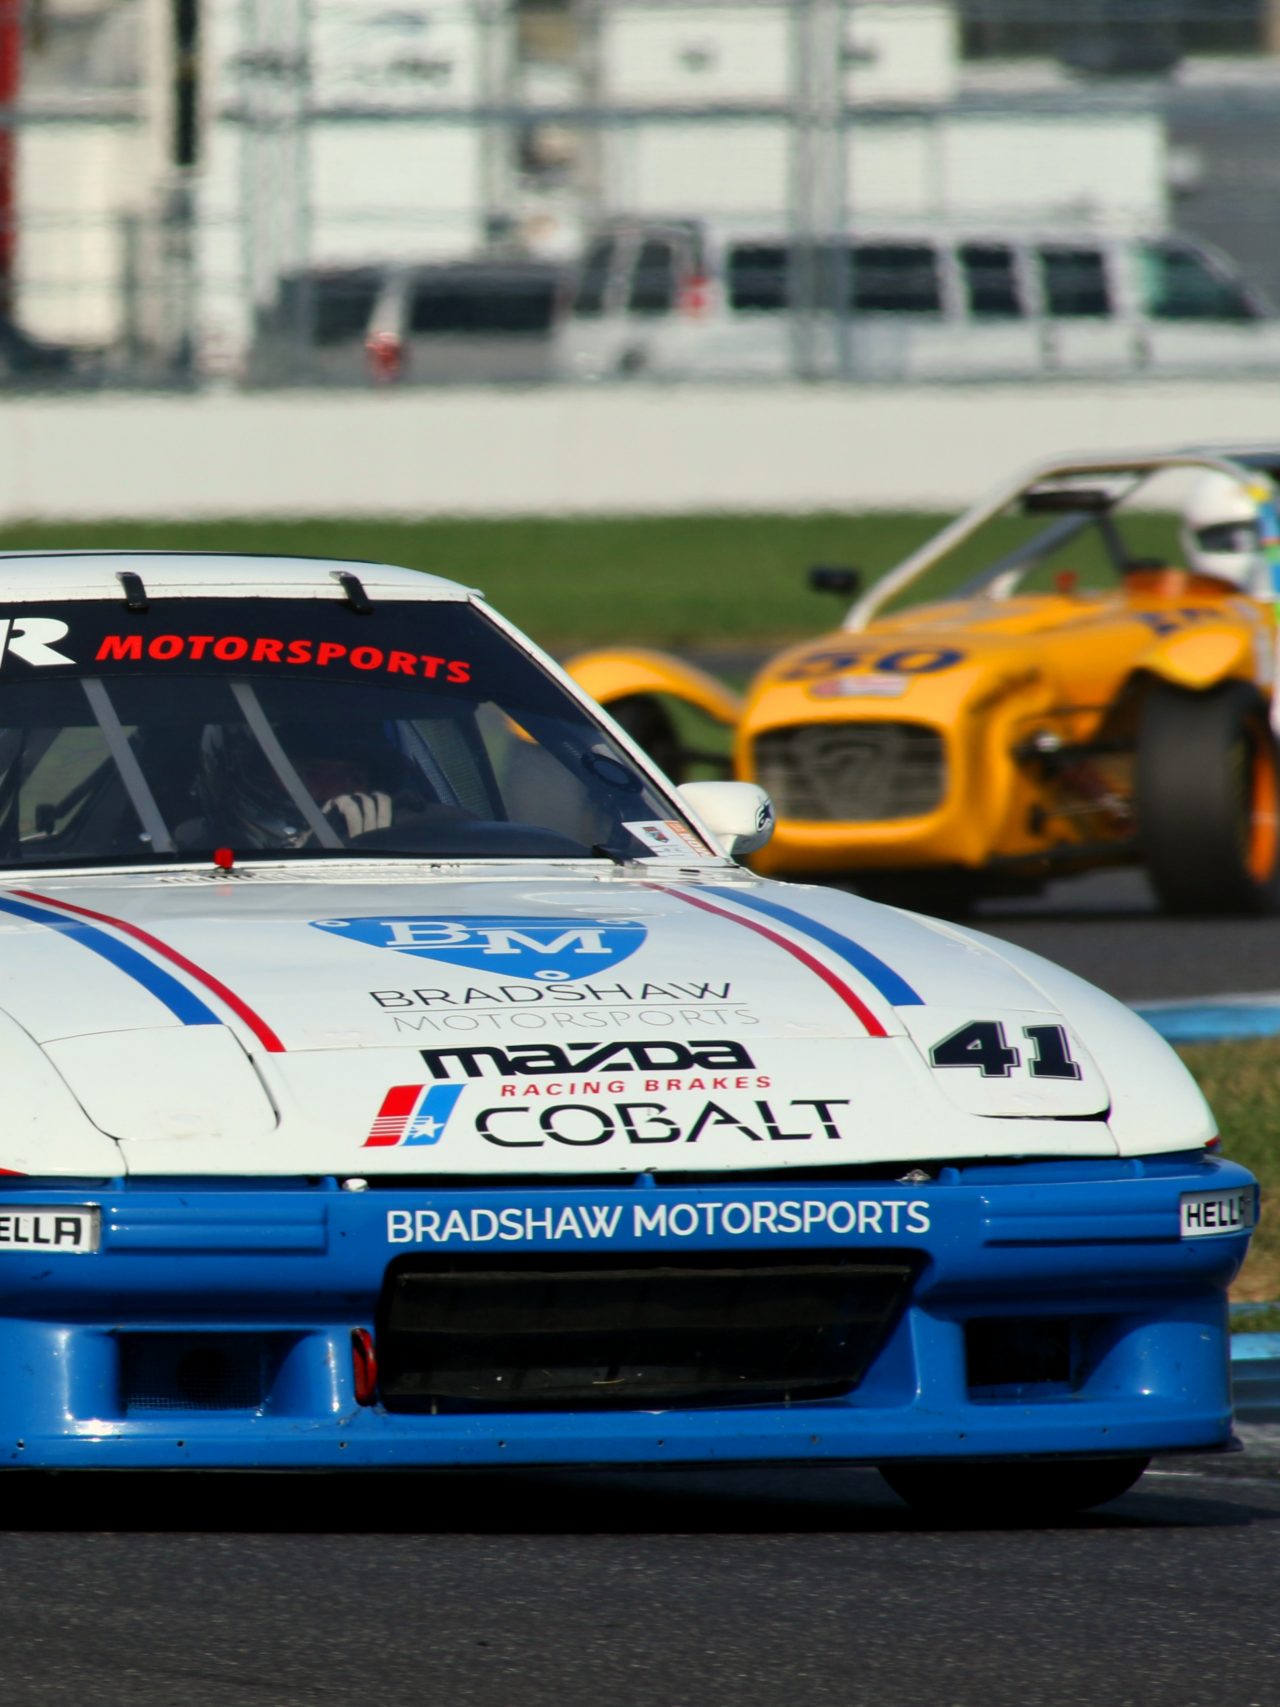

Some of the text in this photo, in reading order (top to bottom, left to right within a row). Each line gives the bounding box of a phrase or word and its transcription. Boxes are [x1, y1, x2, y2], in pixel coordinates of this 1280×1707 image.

[94, 633, 473, 686] MOTORSPORTS
[379, 920, 613, 955] BM
[368, 982, 732, 1009] BRADSHAW
[391, 1007, 761, 1033] MOTORSPORTS
[928, 1019, 1084, 1082] 41
[500, 1074, 773, 1098] RACING BRAKES
[474, 1098, 851, 1148] COBALT
[386, 1200, 932, 1243] BRADSHAW MOTORSPORTS
